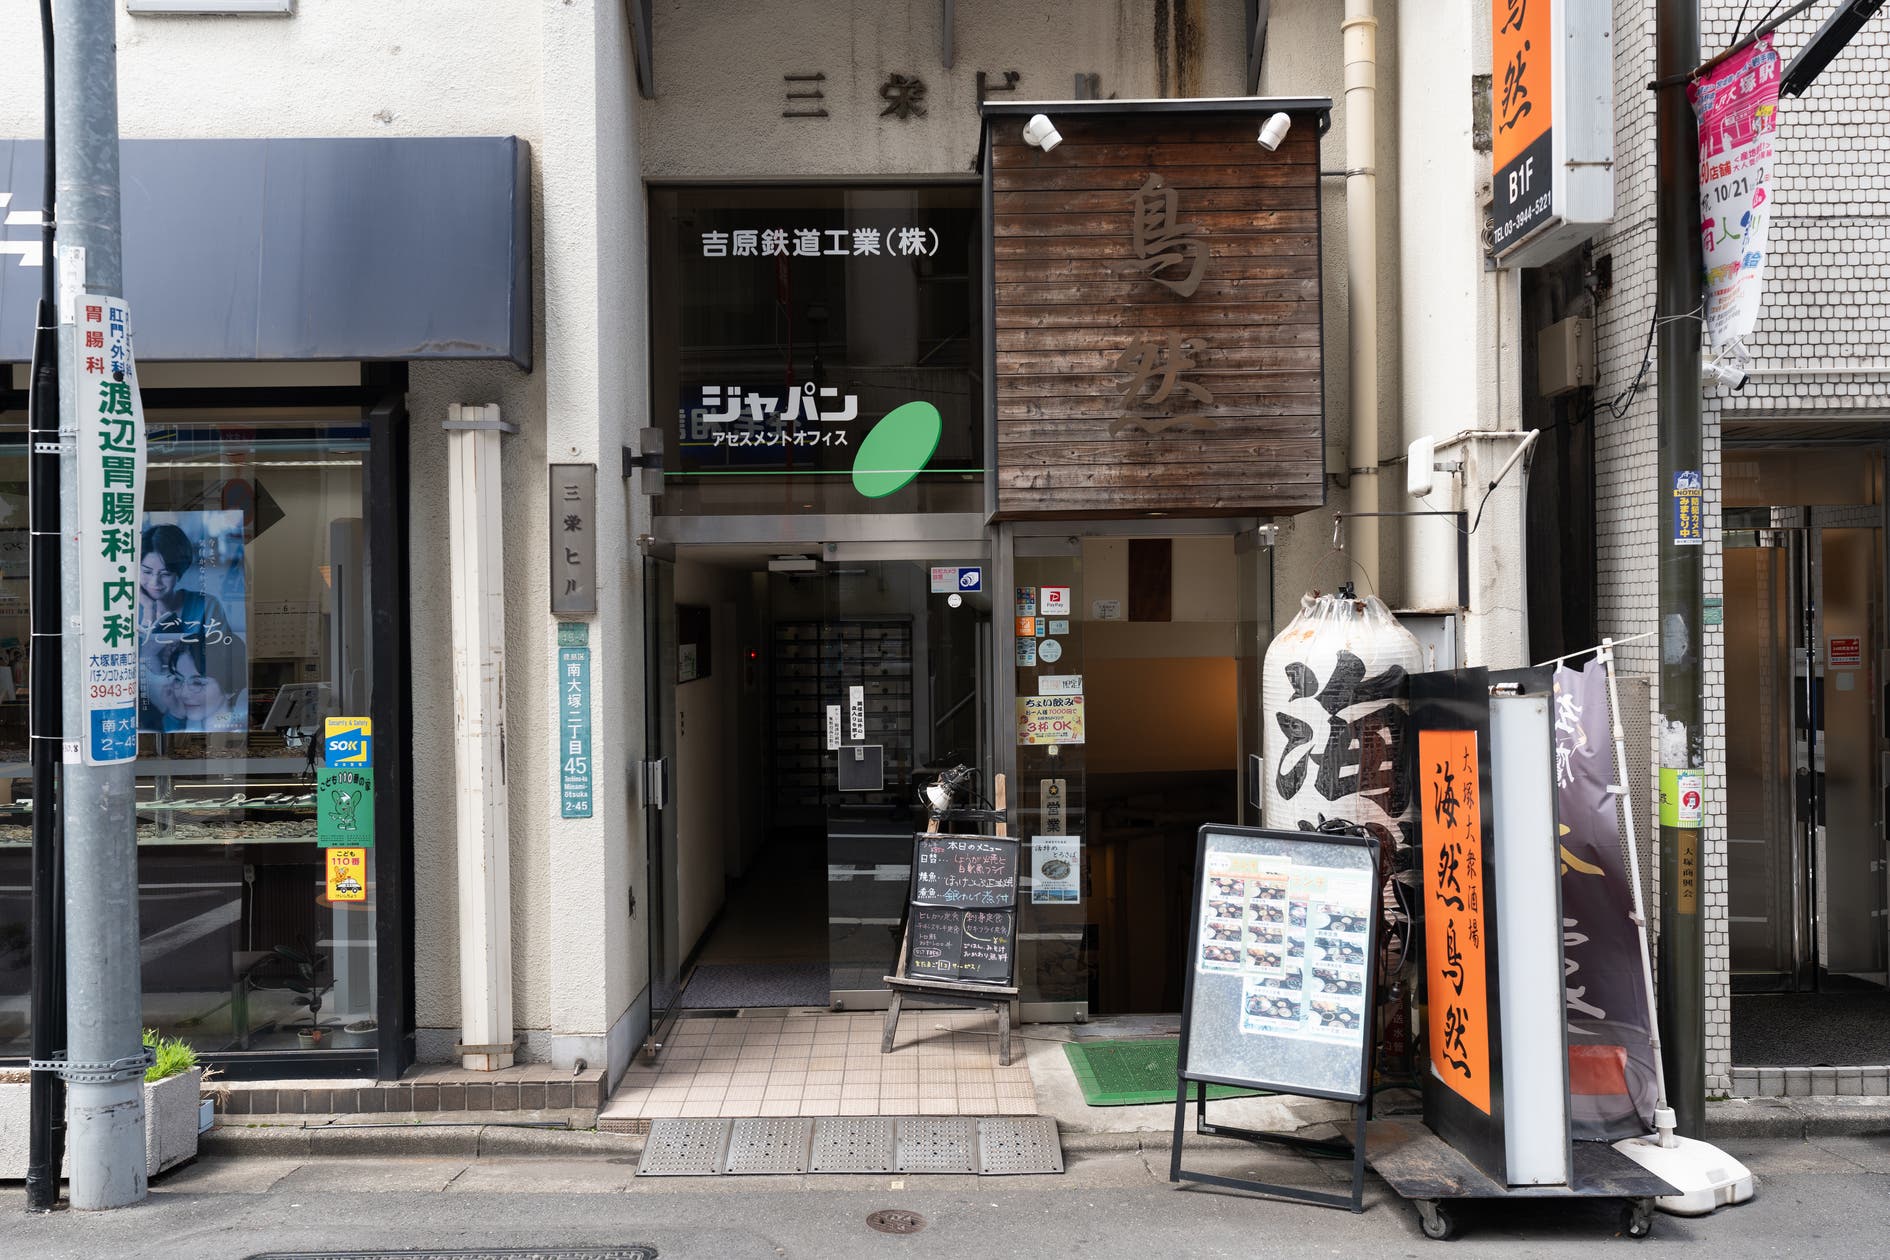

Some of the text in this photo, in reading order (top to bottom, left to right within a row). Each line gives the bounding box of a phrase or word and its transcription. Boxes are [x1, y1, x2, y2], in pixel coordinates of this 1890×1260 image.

[1508, 156, 1534, 205] B1F
[701, 227, 939, 257] 吉原鉄道工業（株）
[86, 305, 104, 374] 胃腸科
[702, 382, 858, 423] ジャパン
[712, 430, 848, 447] アセスメントオフィス
[99, 380, 136, 648] 渡辺胃腸科・内科
[1679, 497, 1690, 538] みまもり中
[567, 663, 583, 755] 南大塚二丁目
[1026, 698, 1074, 708] ちょい飲み
[1053, 720, 1072, 731] OK
[564, 757, 587, 774] 45
[320, 771, 371, 791] こども110番の家
[564, 783, 588, 791] Minami-
[565, 801, 588, 811] 2-45
[947, 841, 1002, 852] 本日のメニュー
[1463, 745, 1480, 950] 大塚大衆酒場
[331, 857, 360, 866] 110番
[1434, 761, 1473, 1080] 海然鳥然
